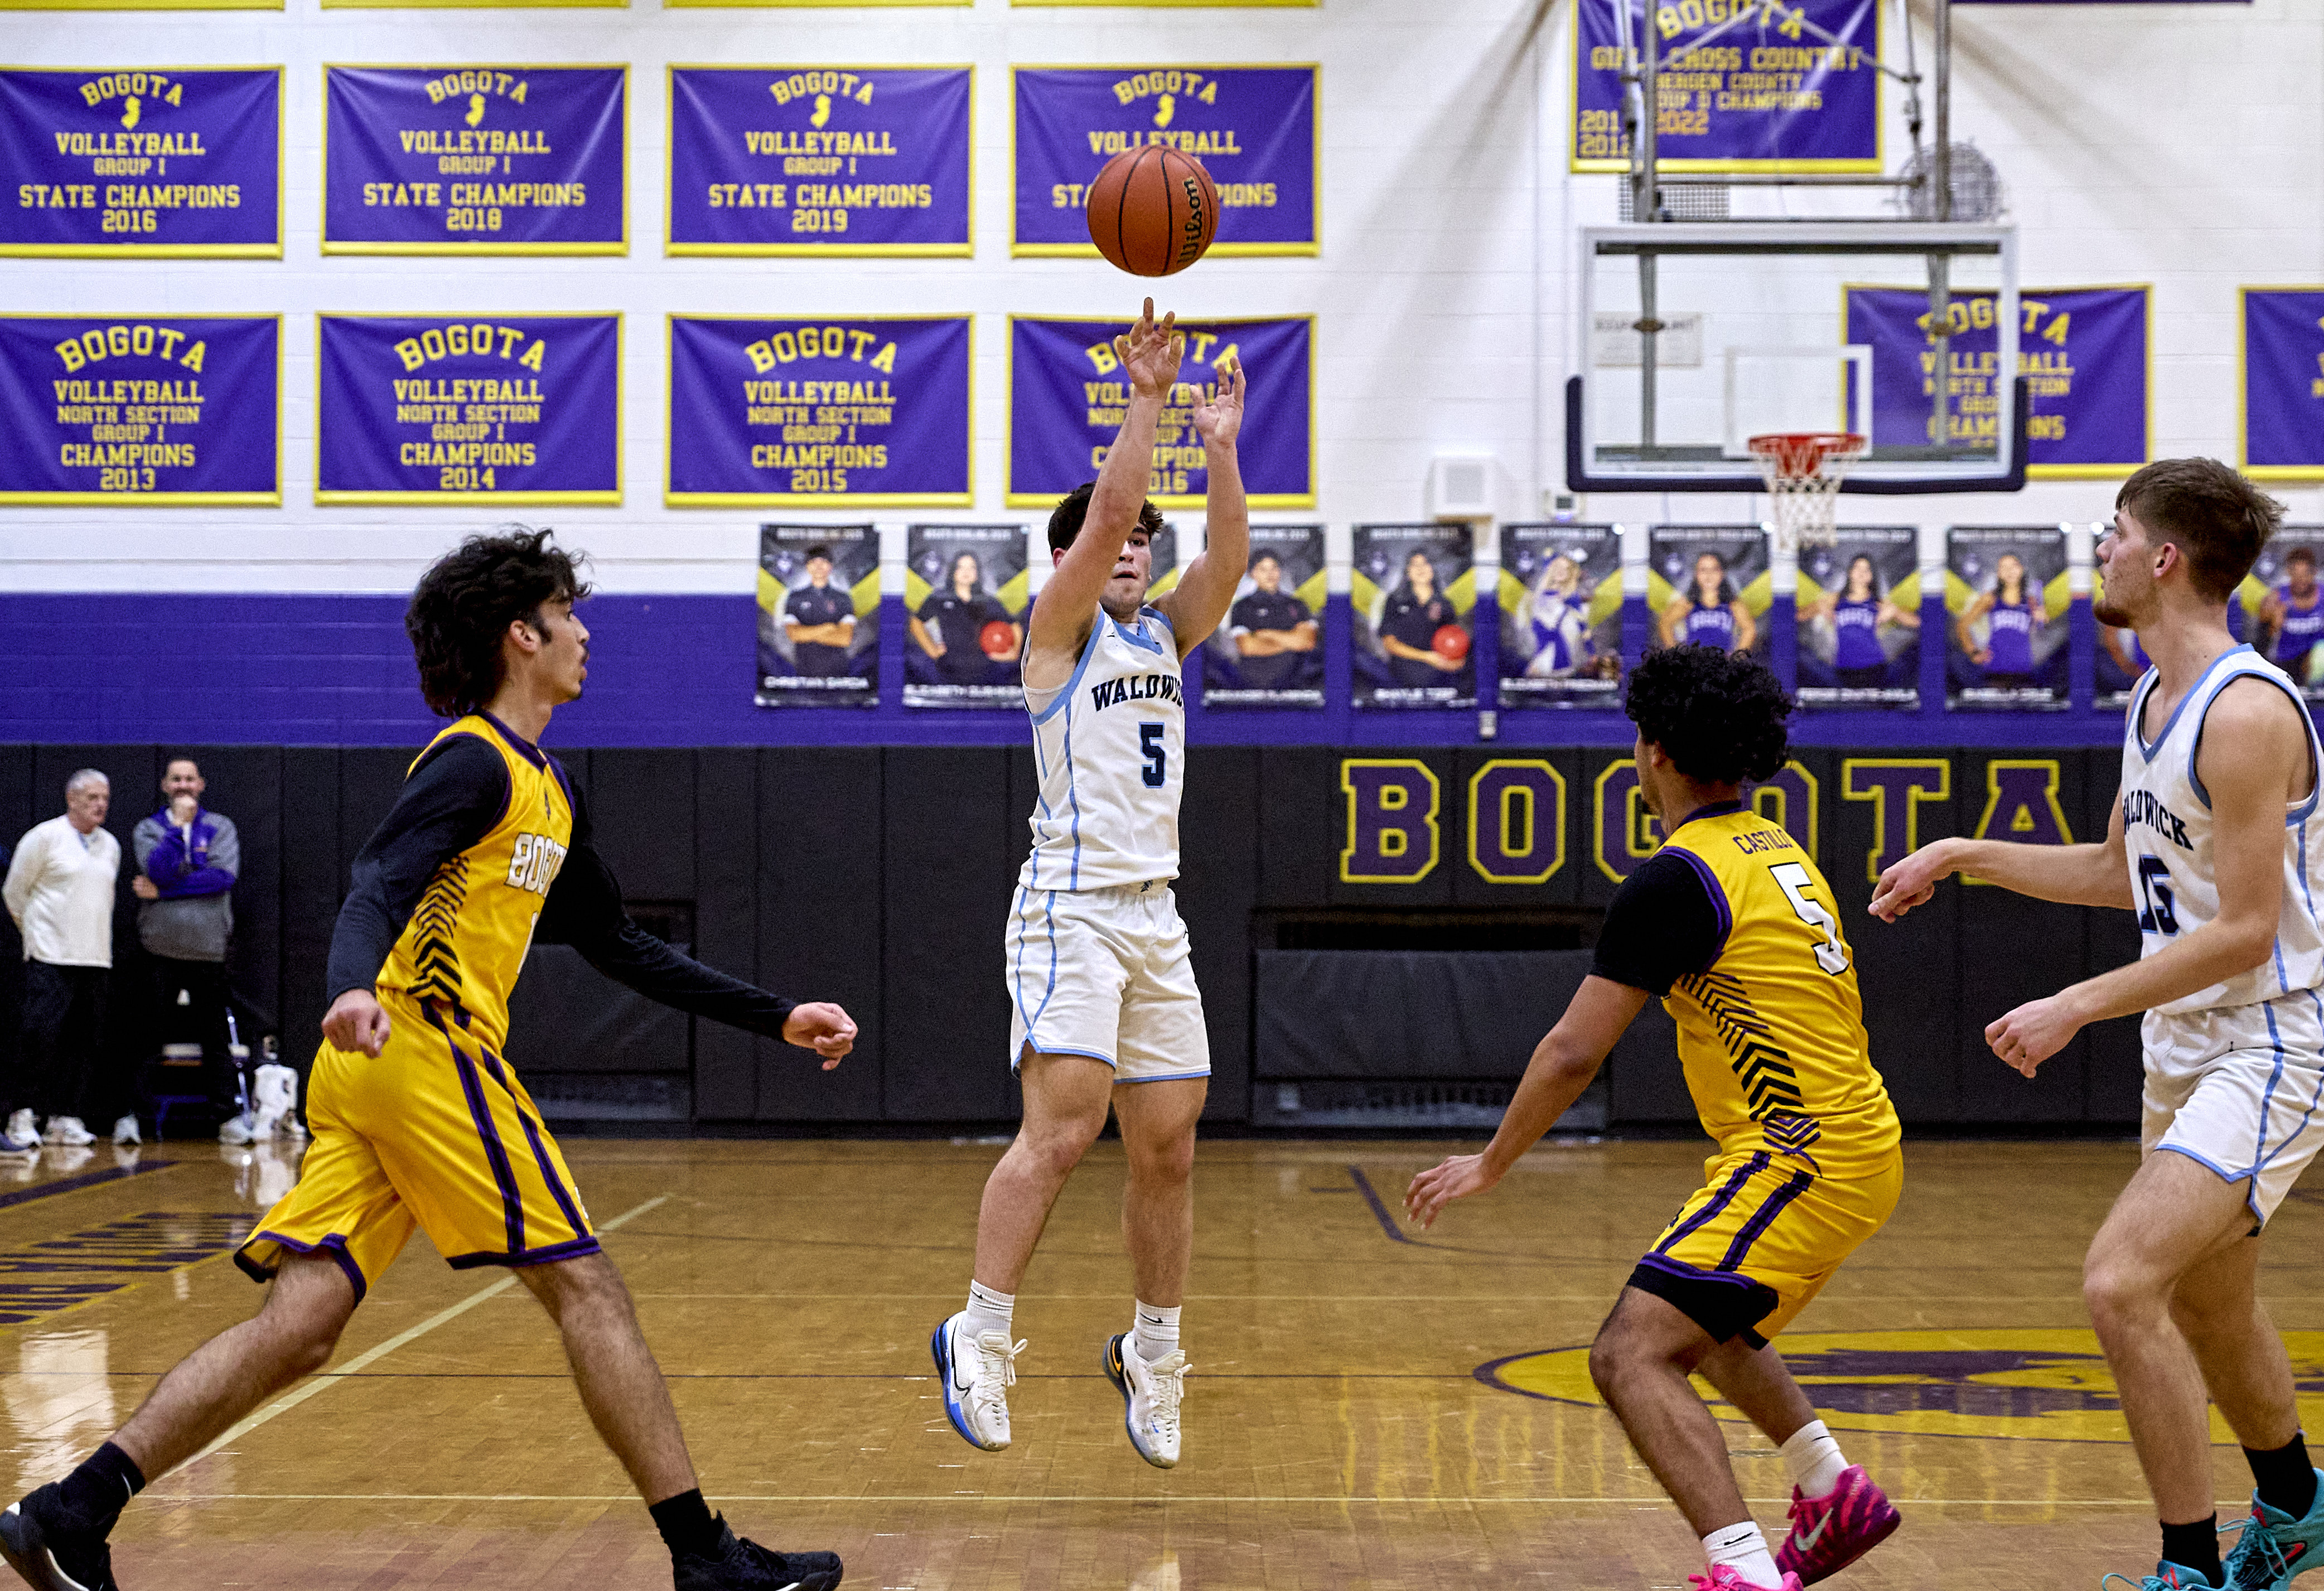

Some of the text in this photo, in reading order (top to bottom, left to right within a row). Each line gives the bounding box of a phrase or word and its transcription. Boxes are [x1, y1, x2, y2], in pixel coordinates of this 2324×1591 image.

[79, 73, 183, 107] BOGOTA
[426, 69, 528, 105] BOGOTA
[770, 71, 873, 105] BOGOTA
[1114, 71, 1216, 105] BOGOTA
[1729, 72, 1803, 90] COUNTY
[1579, 109, 1620, 133] 201
[56, 133, 205, 155] VOLLEYBALL
[400, 131, 550, 153] VOLLEYBALL
[746, 132, 896, 155] VOLLEYBALL
[1087, 130, 1243, 155] VOLLEYBALL
[94, 158, 151, 176] GROUP
[439, 156, 496, 173] GROUP
[784, 157, 842, 175] GROUP
[20, 185, 240, 207] STATE CHAMPIONS
[364, 183, 585, 206] STATE CHAMPIONS
[709, 184, 931, 207] STATE CHAMPIONS
[102, 209, 157, 232] 2016
[447, 207, 501, 230] 2018
[793, 209, 847, 232] 2019
[1176, 176, 1202, 265] Wilson
[1916, 298, 2071, 346] OGTA
[55, 326, 206, 373] BOGOTA
[394, 325, 545, 371] BOGOTA
[745, 327, 896, 373] BOGOTA
[54, 380, 204, 403] VOLLEYBALL
[394, 380, 544, 402] VOLLEYBALL
[744, 381, 896, 404] VOLLEYBALL
[58, 405, 199, 424] NORTH SECTION
[398, 405, 540, 423] NORTH SECTION
[748, 406, 891, 425] NORTH SECTION
[93, 424, 150, 442] GROUP
[432, 423, 490, 441] GROUP
[783, 425, 841, 444] GROUP
[61, 444, 195, 466] CHAMPIONS
[400, 443, 535, 466] CHAMPIONS
[752, 444, 887, 468] CHAMPIONS
[100, 467, 155, 491] 2013
[441, 466, 495, 490] 2014
[791, 468, 847, 492] 2015
[1148, 471, 1188, 493] 016
[1139, 721, 1167, 789] 5
[1340, 759, 2075, 885] BOGOTA
[2123, 790, 2194, 851] ALDWICK
[1732, 829, 1793, 855] CASTILLO
[1767, 862, 1849, 976] 5
